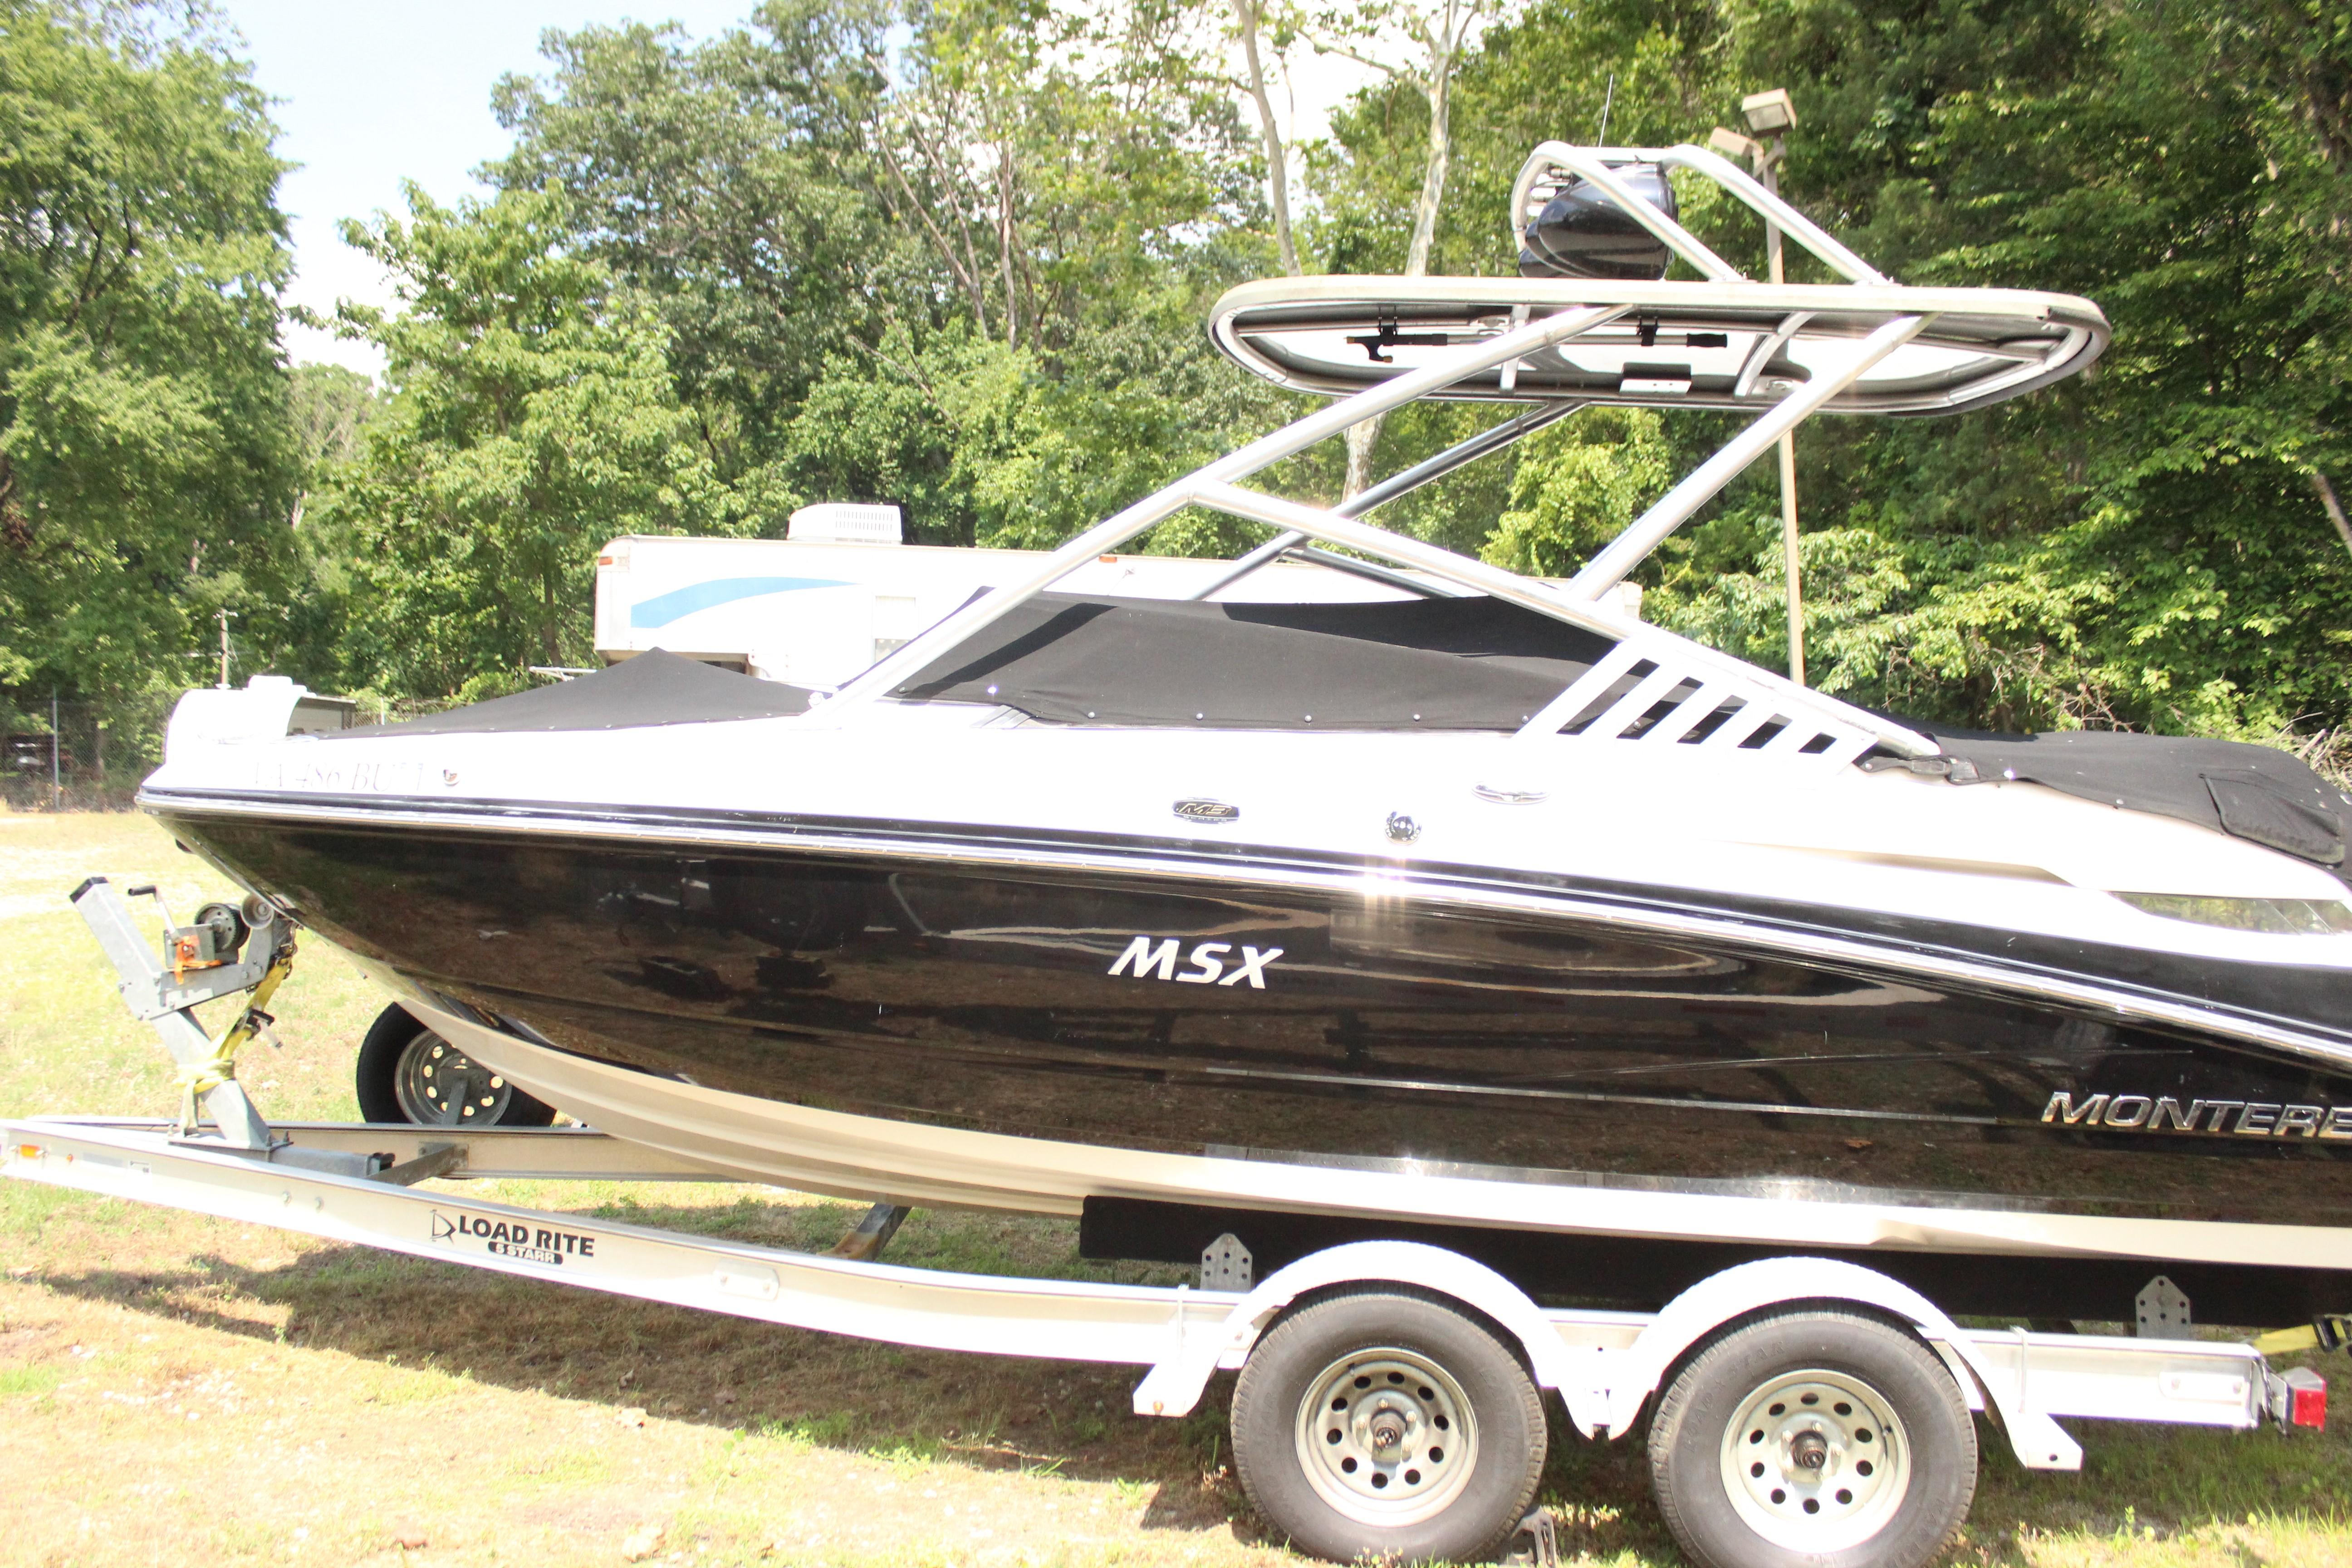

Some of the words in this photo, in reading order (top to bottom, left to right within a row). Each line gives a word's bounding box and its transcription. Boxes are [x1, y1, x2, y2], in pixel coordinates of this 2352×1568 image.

[1107, 936, 1284, 990] MSX
[459, 1215, 529, 1245] LOAD
[536, 1229, 595, 1256] RITE
[495, 1243, 506, 1255] 5
[506, 1245, 556, 1264] STARR
